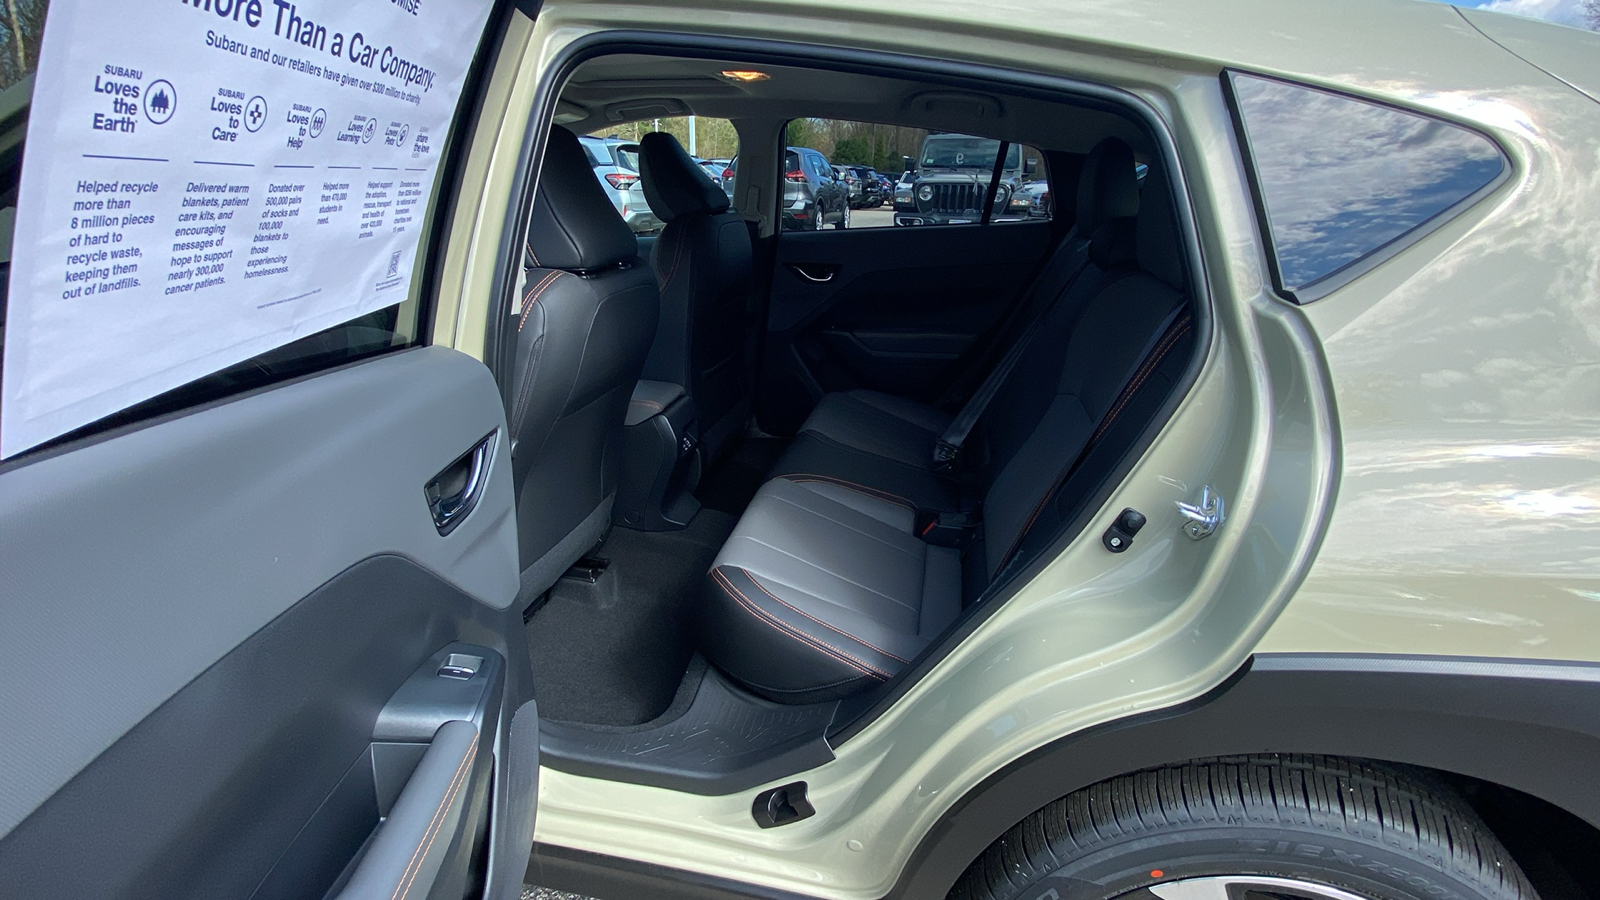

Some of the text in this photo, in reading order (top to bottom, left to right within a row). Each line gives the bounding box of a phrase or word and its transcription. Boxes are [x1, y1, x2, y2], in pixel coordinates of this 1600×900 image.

[273, 0, 328, 51] Than
[331, 32, 344, 58] a
[349, 33, 380, 68] Car
[104, 64, 143, 80] SUBARU
[206, 30, 248, 56] Subaru
[250, 46, 271, 63] and
[272, 53, 288, 68] our
[288, 57, 322, 77] retailers
[323, 66, 340, 83] have
[341, 72, 359, 88] given
[359, 79, 373, 91] over
[372, 81, 386, 95] $300
[385, 86, 401, 99] million
[401, 90, 407, 101] to
[94, 75, 140, 98] Loves
[218, 88, 245, 100] SUBARU
[113, 97, 138, 116] the
[210, 97, 242, 115] Loves
[293, 103, 312, 113] SUBARU
[93, 113, 136, 133] Earth
[229, 115, 239, 129] to
[286, 110, 309, 125] Loves
[299, 126, 307, 136] to
[348, 121, 364, 132] Loves
[212, 127, 237, 142] Care
[337, 131, 361, 145] Learning
[287, 136, 303, 150] Help
[77, 180, 159, 195] Helped recycle
[186, 182, 249, 194] Delivered warm
[268, 183, 305, 193] Donated over
[323, 182, 339, 192] Helped
[73, 198, 131, 211] more than
[182, 197, 249, 208] blankets, patient
[265, 195, 302, 207] 500,000 pairs
[178, 210, 233, 222] care kits, and
[262, 207, 300, 219] of socks and
[319, 204, 338, 214] students
[71, 213, 155, 229] 8 million pieces
[258, 220, 283, 231] 100,000
[175, 223, 226, 237] encouraging
[69, 232, 123, 247] of hard to
[173, 237, 225, 252] messages of
[253, 232, 289, 243] blankets to
[67, 246, 143, 267] recycle waste,
[250, 245, 269, 255] those
[170, 249, 233, 268] hope to support
[246, 255, 288, 268] experiencing
[65, 262, 138, 283] keeping them
[167, 263, 224, 282] nearly 300,000
[243, 266, 289, 279] homelessness.
[62, 277, 141, 300] out of landfills.
[164, 276, 226, 296] cancer patients.
